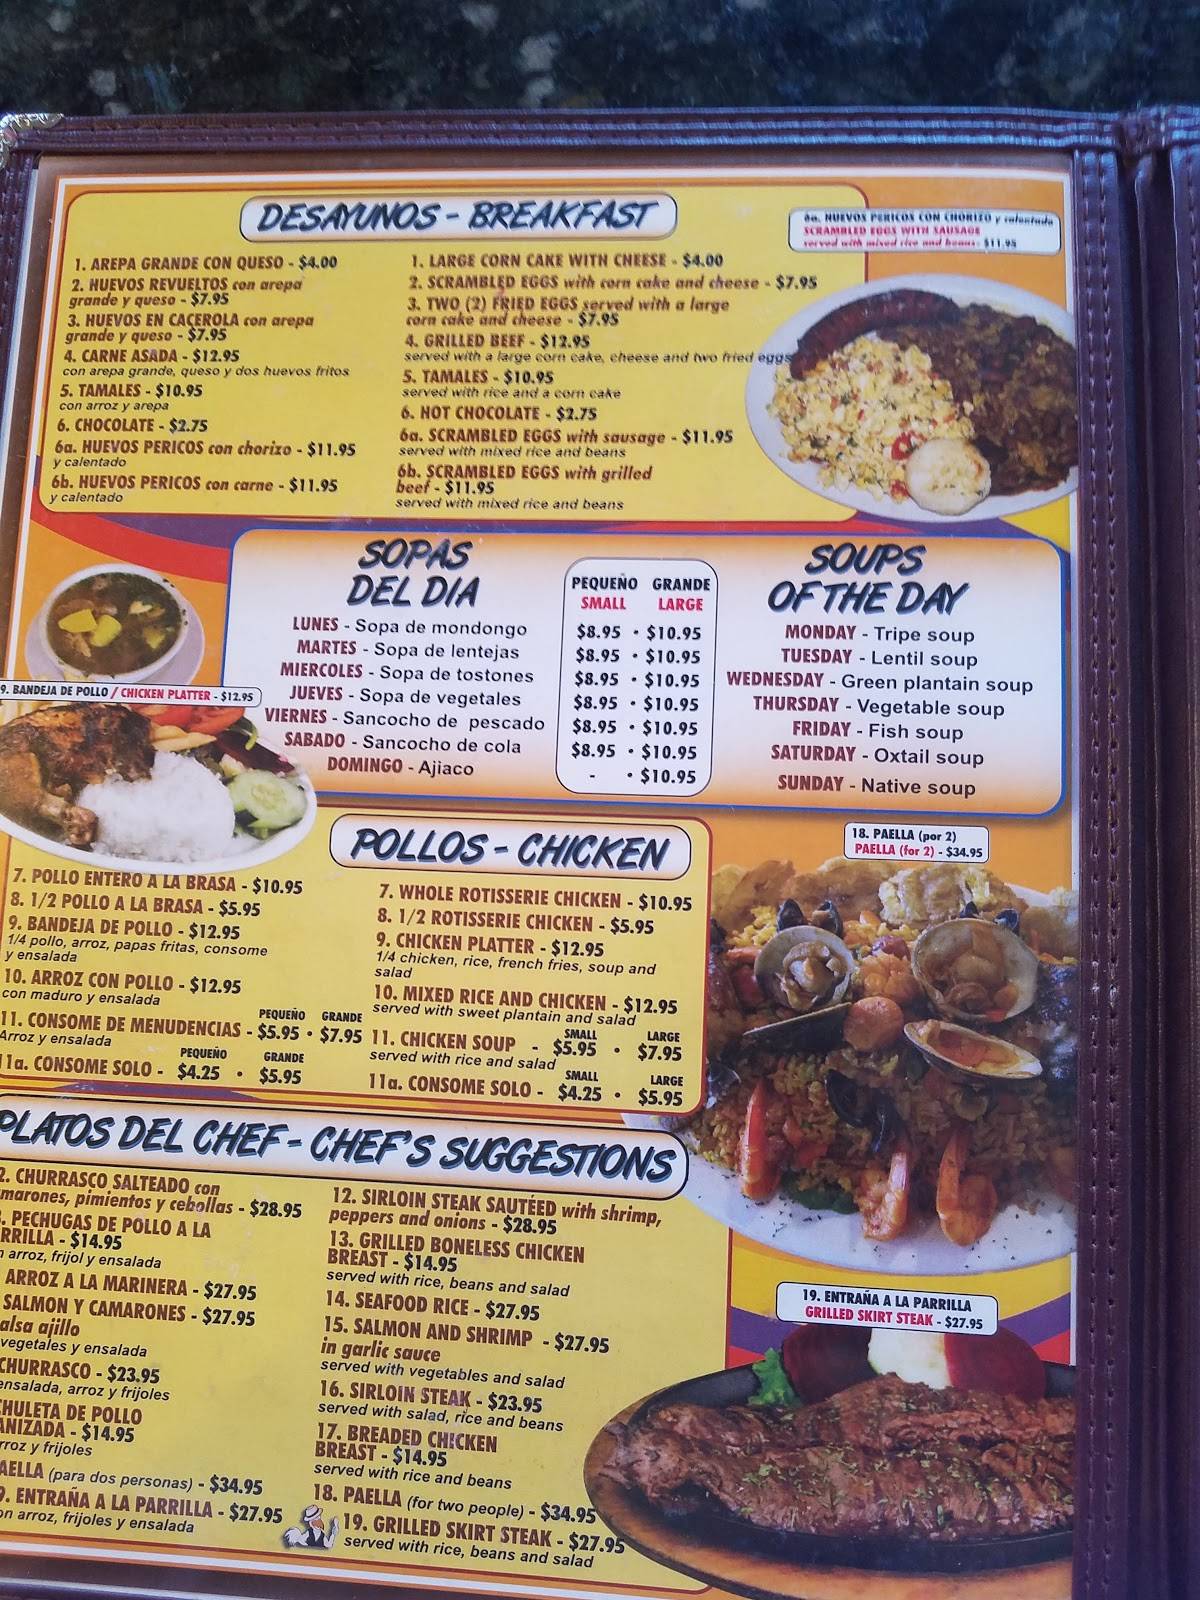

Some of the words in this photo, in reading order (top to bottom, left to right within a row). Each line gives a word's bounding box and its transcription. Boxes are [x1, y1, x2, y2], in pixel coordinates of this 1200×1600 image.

[257, 201, 440, 232] DESAYUNOS
[468, 201, 660, 231] BREAKFAST
[919, 213, 940, 222] CON
[944, 214, 992, 223] CHORIZO
[804, 227, 866, 235] SCRAMBLED
[871, 227, 896, 235] EGGS
[901, 227, 929, 235] WITH
[933, 227, 980, 235] SAUSAGE
[984, 239, 1017, 248] $11.95
[75, 258, 86, 271] 1.
[91, 257, 136, 271] AREPA
[141, 257, 198, 270] GRANDE
[203, 257, 231, 270] CON
[237, 256, 283, 270] QUESO
[299, 255, 337, 270] $4.00
[412, 255, 424, 268] 1.
[429, 254, 475, 267] LARGE
[480, 254, 520, 267] CORN
[526, 254, 563, 267] CAKE
[568, 254, 608, 267] WITH
[614, 254, 666, 267] CHEESE
[682, 253, 723, 268] $4.00
[64, 350, 77, 362] 4.
[82, 350, 127, 363] CARNE
[131, 350, 178, 362] ASADA
[192, 349, 240, 363] $12.95
[63, 366, 85, 375] con
[89, 367, 124, 378] arepa
[128, 366, 176, 378] grande,
[181, 367, 220, 378] queso
[224, 368, 231, 378] y
[236, 365, 259, 376] dos
[263, 365, 311, 376] huevos
[316, 365, 349, 376] fritos
[57, 419, 70, 432] 6.
[75, 419, 154, 432] CHOCOLATE
[169, 419, 208, 433] $2.75
[358, 540, 473, 571] SOPAS
[805, 542, 927, 576] SOUPS
[347, 575, 412, 606] DEL
[421, 577, 480, 608] DIA
[572, 573, 638, 591] PEQUEÑO
[652, 577, 711, 592] GRANDE
[581, 597, 626, 610] SMALL
[658, 598, 704, 611] LARGE
[895, 582, 970, 615] DAY
[293, 616, 338, 632] LUNES
[355, 619, 401, 636] Sopa
[406, 621, 426, 634] de
[431, 622, 527, 638] mondongo
[577, 624, 621, 640] $8.95
[646, 625, 701, 641] $10.95
[785, 625, 856, 640] MONDAY
[874, 626, 921, 645] Tripe
[927, 629, 975, 646] soup
[0, 685, 9, 695] 9.
[13, 685, 57, 696] BANDEJA
[60, 687, 73, 696] DE
[76, 687, 109, 697] POLLO
[121, 688, 164, 698] CHICKEN
[168, 690, 210, 700] PLATTER
[221, 692, 253, 702] $12.95
[727, 672, 824, 688] WEDNESDAY
[841, 674, 897, 690] Green
[904, 677, 980, 695] plantain
[986, 680, 1033, 696] soup
[327, 758, 402, 774] DOMINGO
[418, 760, 474, 778] Ajiaco
[777, 775, 844, 792] SUNDAY
[861, 778, 921, 794] Native
[927, 782, 976, 799] soup
[852, 828, 870, 839] 18.
[873, 828, 914, 840] PAELLA
[919, 830, 943, 843] (por
[946, 831, 956, 843] 2)
[351, 828, 488, 865] POLLOS
[517, 832, 671, 871] CHICKEN
[855, 844, 895, 856] PAELLA
[900, 845, 919, 858] (for
[922, 846, 935, 858] 2)
[946, 846, 983, 858] $34.95
[11, 892, 24, 906] 8.
[31, 892, 56, 907] 1/2
[61, 894, 110, 910] POLLO
[115, 896, 124, 910] A
[129, 897, 148, 912] LA
[154, 898, 203, 914] BRASA
[219, 900, 261, 917] $5.95
[379, 883, 393, 899] 7.
[399, 885, 453, 901] WHOLE
[459, 887, 549, 905] ROTISSERIE
[554, 891, 621, 908] CHICKEN
[639, 894, 692, 912] $10.95
[376, 951, 395, 963] 1/4
[400, 952, 457, 967] chicken,
[463, 955, 491, 968] rice,
[498, 957, 543, 970] french
[548, 959, 583, 972] fries,
[588, 962, 623, 975] soup
[629, 963, 656, 975] and
[4, 968, 26, 985] 10.
[31, 970, 83, 987] ARROZ
[88, 972, 120, 989] CON
[125, 974, 173, 991] POLLO
[189, 976, 241, 994] $12.95
[2, 989, 27, 999] con
[31, 989, 83, 1002] maduro
[86, 994, 94, 1005] y
[99, 992, 160, 1005] ensalada
[118, 1115, 183, 1152] DEL
[193, 1120, 289, 1158] CHEF
[311, 1126, 436, 1168] CHEF'S
[440, 1136, 676, 1184] SUGGESTIONS
[326, 1271, 376, 1284] served
[380, 1273, 409, 1286] with
[414, 1276, 444, 1289] rice,
[449, 1277, 494, 1291] beans
[499, 1281, 526, 1294] and
[531, 1283, 570, 1297] salad
[803, 1289, 820, 1301] 19.
[825, 1290, 879, 1305] ENTRAÑA
[884, 1296, 891, 1306] A
[895, 1297, 909, 1307] LA
[913, 1298, 971, 1311] PARRILLA
[806, 1306, 853, 1320] GRILLED
[858, 1309, 892, 1322] SKIRT
[897, 1312, 933, 1326] STEAK
[945, 1316, 983, 1329] $27.95
[0, 1339, 66, 1351] vegetales
[72, 1343, 80, 1354] y
[84, 1344, 147, 1357] ensalada
[344, 1513, 367, 1531] 19.
[374, 1516, 440, 1538] GRILLED
[446, 1522, 495, 1541] SKIRT
[501, 1527, 551, 1547] STEAK
[569, 1532, 625, 1554] $27.95
